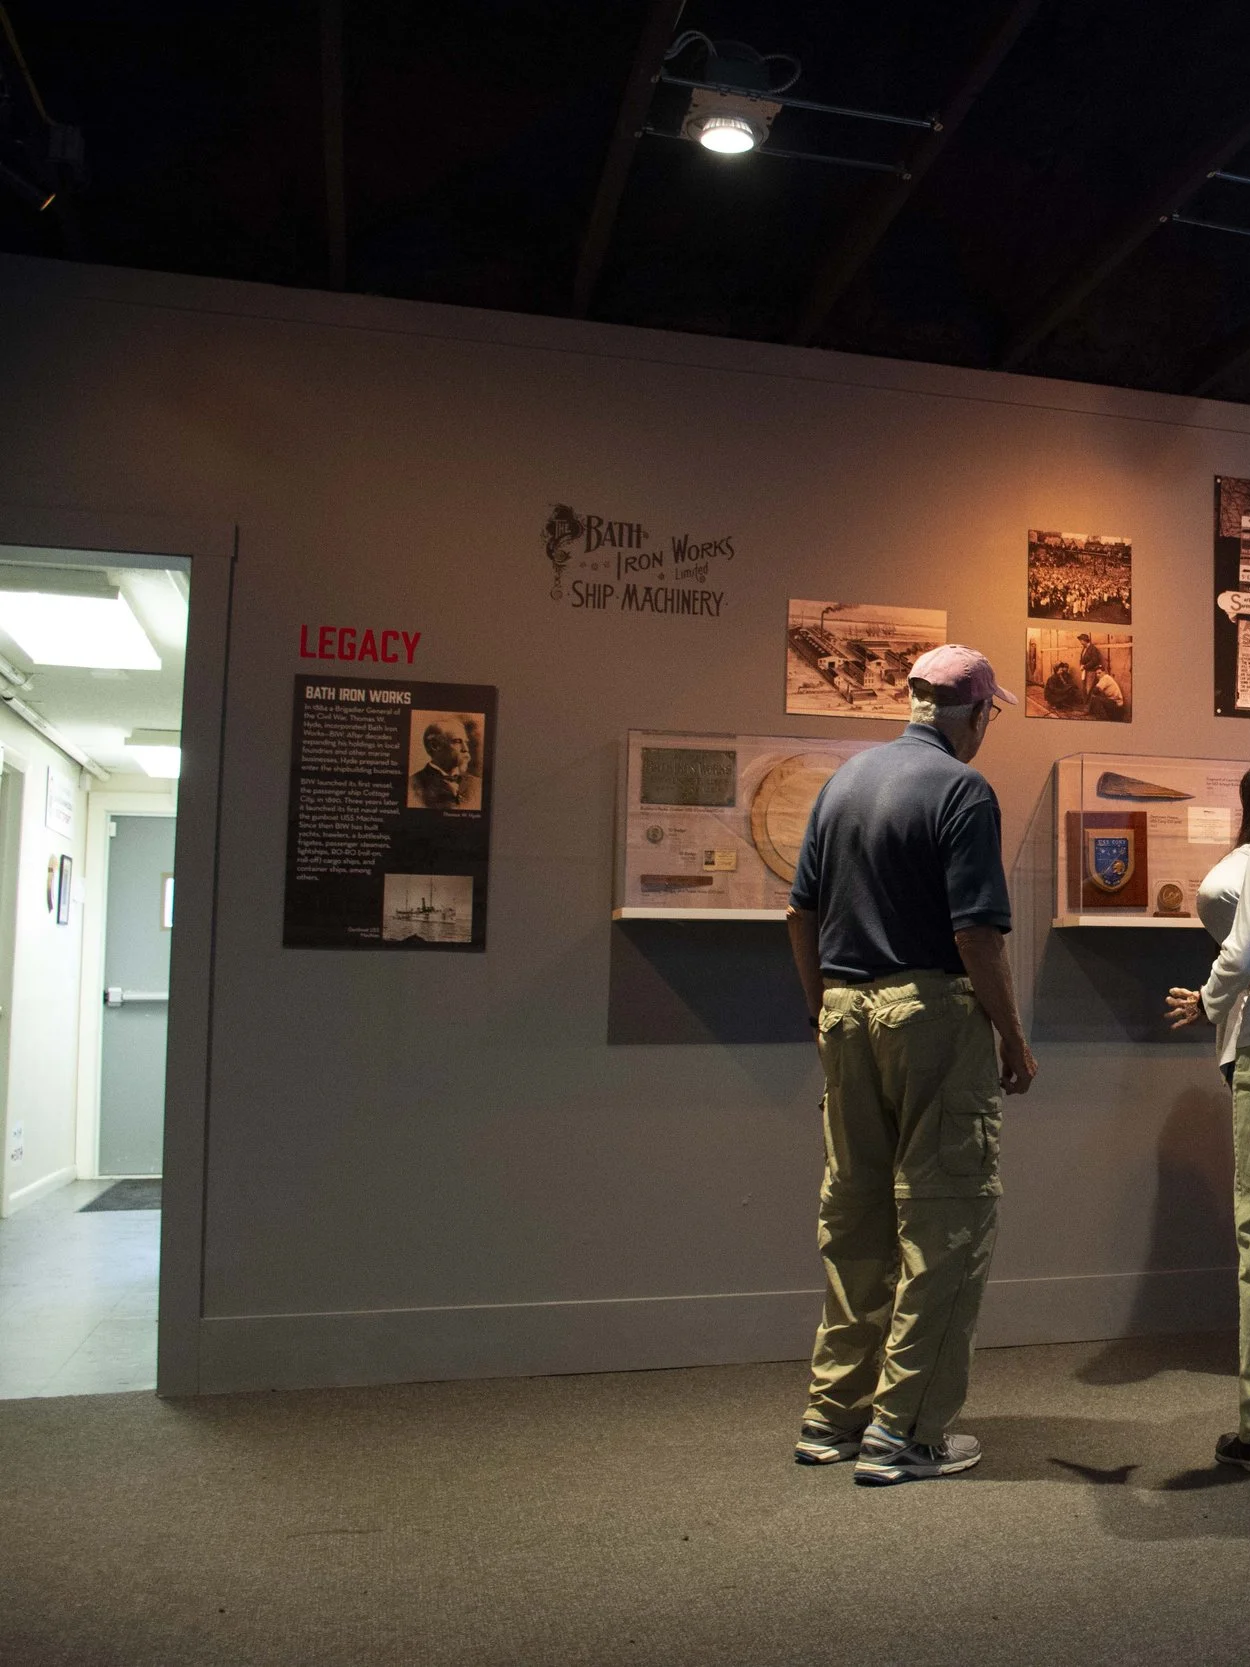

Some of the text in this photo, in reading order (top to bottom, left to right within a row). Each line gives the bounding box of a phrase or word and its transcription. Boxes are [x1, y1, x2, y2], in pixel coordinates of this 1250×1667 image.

[584, 515, 643, 553] BATH
[616, 534, 735, 581] IRON WORKS
[571, 580, 724, 617] SHIP MACHINERY
[300, 624, 422, 664] LEGACY
[306, 686, 411, 704] BATH IRON WORKS
